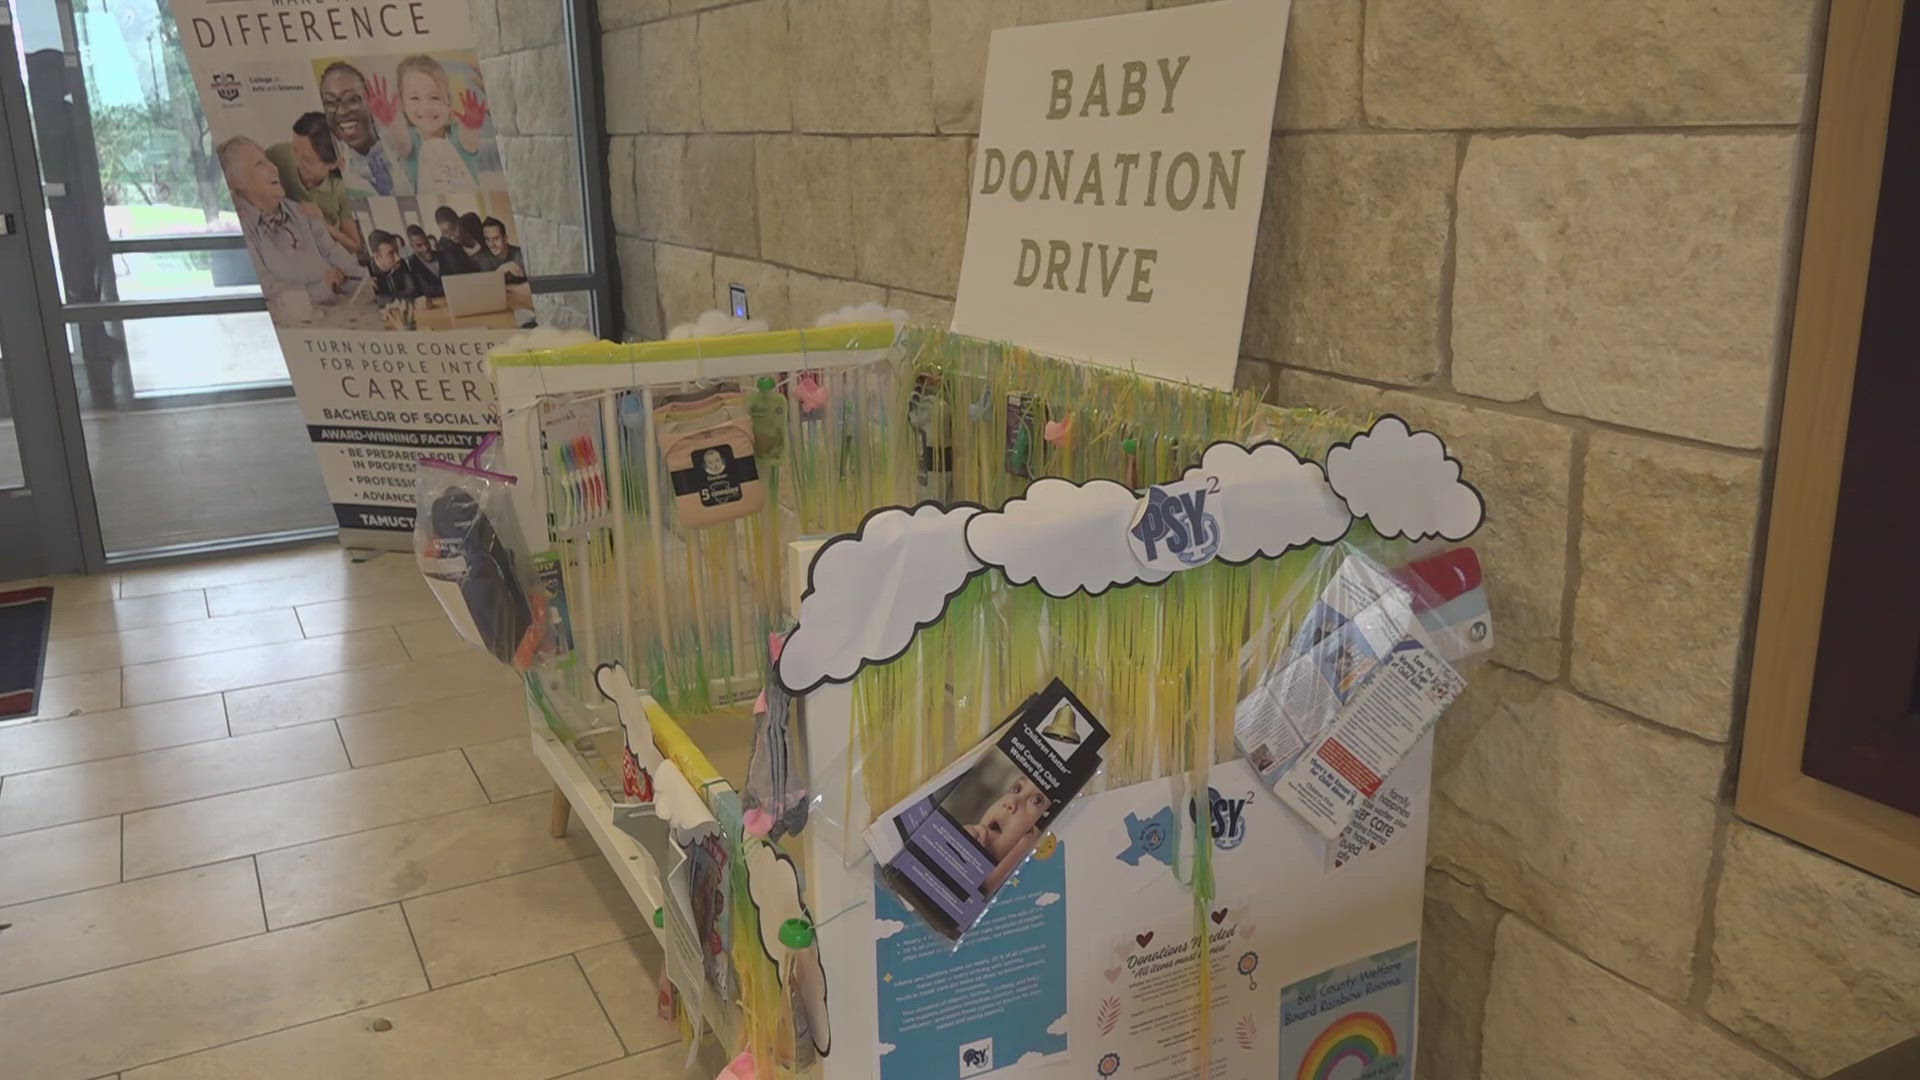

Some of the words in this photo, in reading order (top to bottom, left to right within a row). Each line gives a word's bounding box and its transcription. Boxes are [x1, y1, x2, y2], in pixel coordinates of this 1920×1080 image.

[192, 3, 430, 49] DIFFERENCE
[1046, 55, 1190, 120] BABY
[980, 147, 1246, 212] DONATION
[1013, 238, 1158, 303] DRIVE
[305, 340, 352, 353] TURN
[359, 342, 406, 356] YOUR
[320, 358, 352, 371] FOR
[362, 359, 429, 374] PEOPLE
[341, 376, 499, 402] CAREER!
[323, 408, 396, 424] BACHELOR
[400, 412, 419, 424] OF
[424, 413, 479, 426] SOCIAL
[321, 430, 419, 445] AWARD-WINNING
[420, 433, 474, 446] FACULTY
[348, 448, 364, 458] BE
[366, 449, 426, 462] PREPARED
[352, 460, 365, 470] IN
[1010, 746, 1034, 773] Welfare
[1032, 770, 1052, 791] Board
[1011, 736, 1026, 752] Bell
[1023, 749, 1045, 773] County
[1043, 770, 1060, 788] Child
[1370, 816, 1395, 838] care
[1126, 942, 1188, 969] Donations
[1297, 985, 1317, 1006] Bell
[1320, 975, 1357, 998] County
[1360, 961, 1402, 982] Welfare
[1284, 1006, 1317, 1026] Board
[1320, 992, 1362, 1014] Rainbow
[1365, 977, 1402, 996] Rooms
